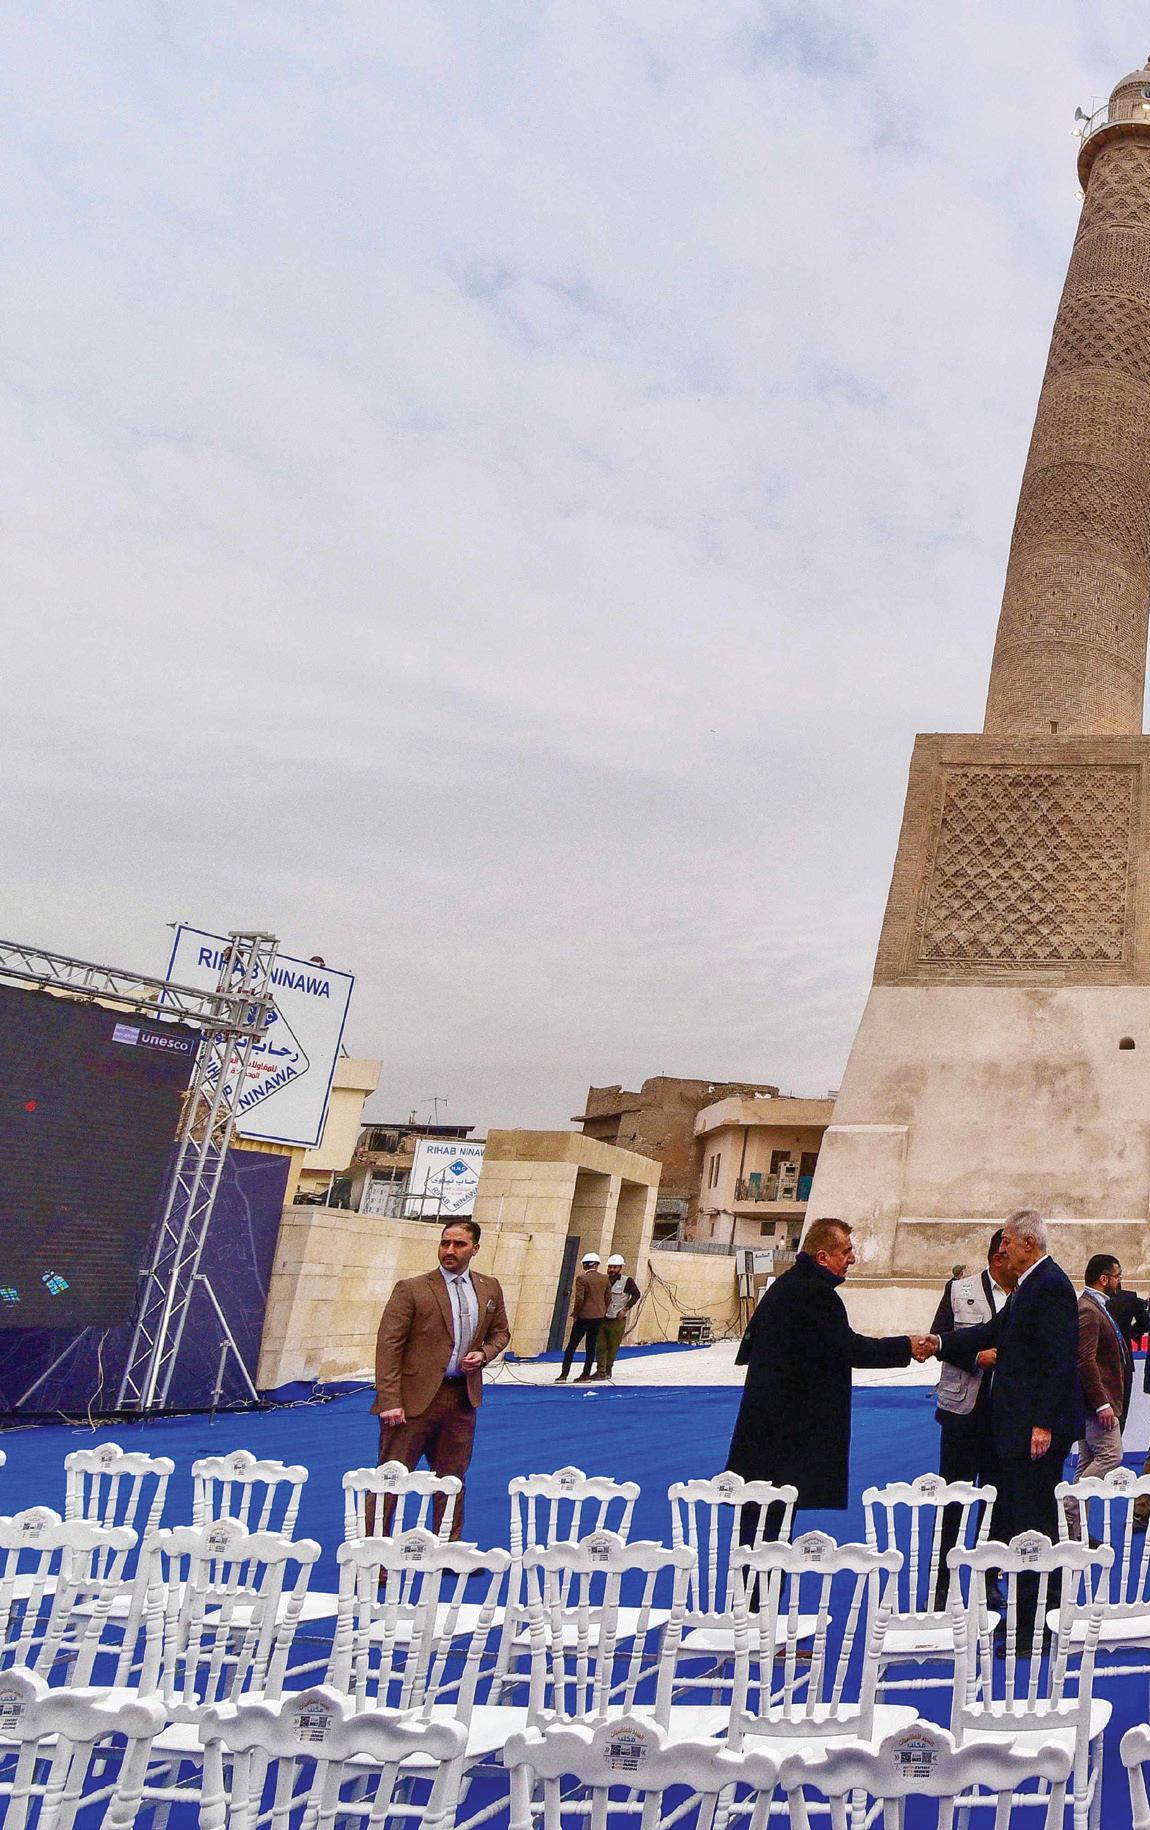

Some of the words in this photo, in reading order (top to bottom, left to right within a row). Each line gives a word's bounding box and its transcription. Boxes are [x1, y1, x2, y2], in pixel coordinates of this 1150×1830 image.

[269, 966, 330, 998] NINAWA
[141, 1033, 188, 1051] unesco
[238, 1066, 297, 1109] NINAWA
[427, 1146, 456, 1156] RIHAB
